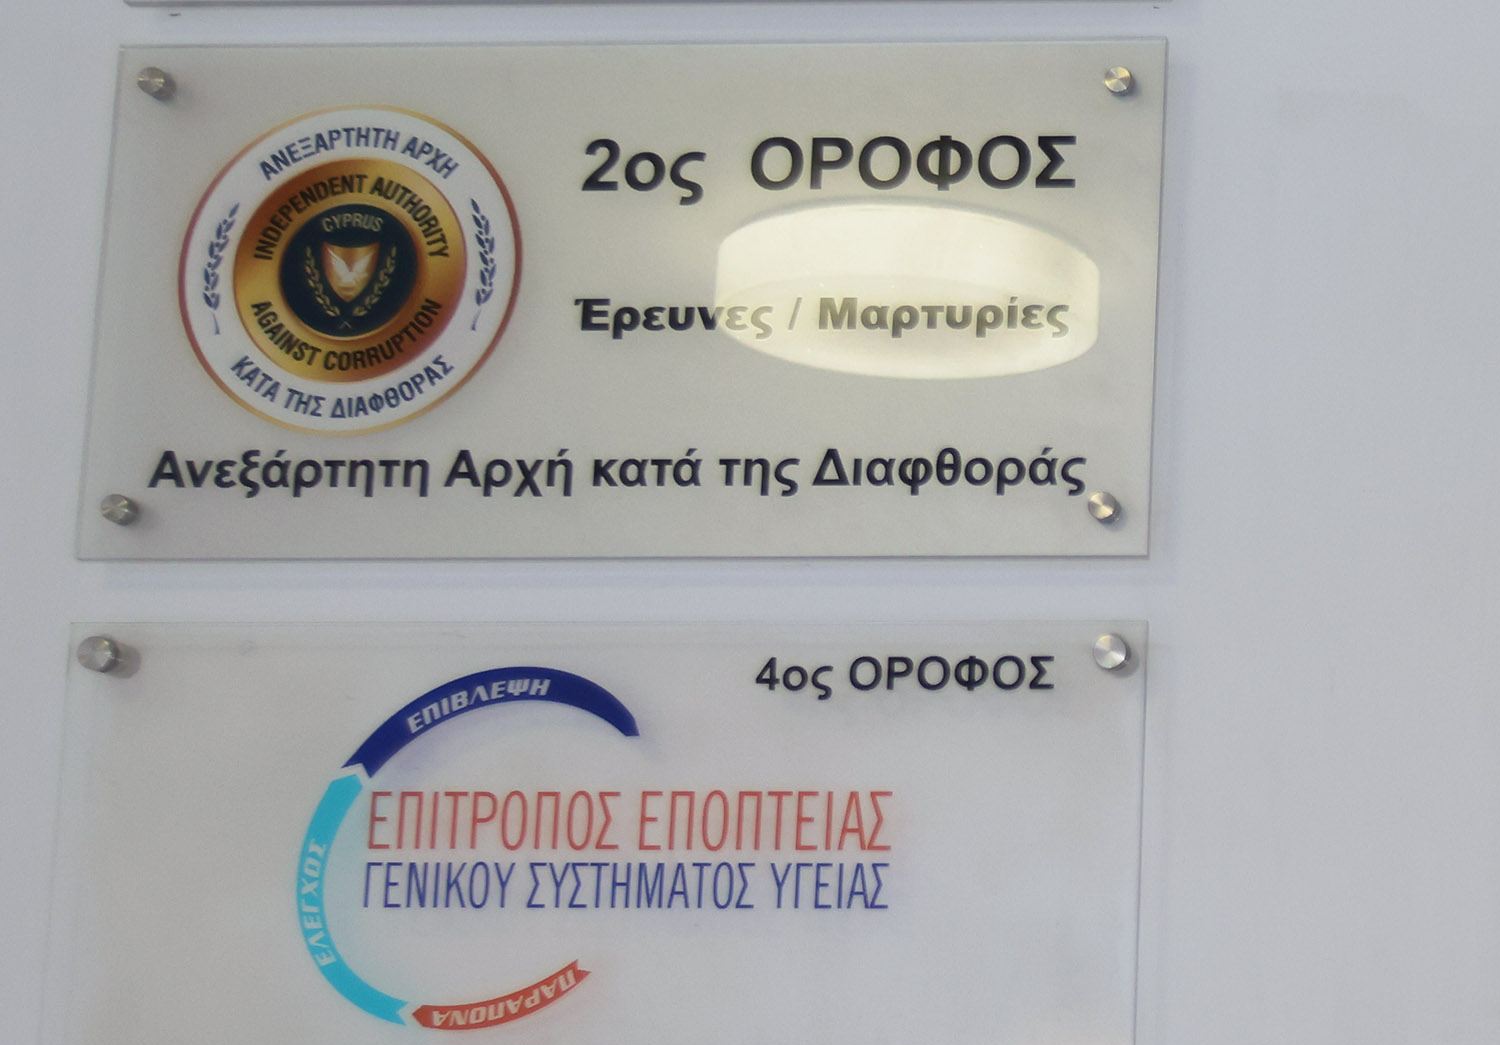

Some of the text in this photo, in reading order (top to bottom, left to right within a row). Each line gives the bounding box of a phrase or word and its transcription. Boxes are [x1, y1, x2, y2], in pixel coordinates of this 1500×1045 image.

[259, 126, 460, 181] ΑΝΕΞΑΡΤΗΤΗ ΑΡΧΗ
[581, 135, 1078, 206] 2ος ΟΡΟΦΟΣ
[253, 174, 451, 260] INDEPENDENT AUTHORITY
[321, 212, 385, 233] CYPRUS
[250, 298, 443, 371] AGAINST CORRUPTION
[574, 297, 774, 340] Έρευνες
[818, 296, 1071, 339] Μαρτυρίες
[230, 354, 455, 420] ΚΑΤΑ ΤΗΣ ΔΙΑΦΘΟΡΑΣ
[148, 446, 1087, 498] Ανεξάρτητη Αρχή κατά της Διαφθοράς
[405, 677, 552, 736] ΕΠΙΒΛΕΨΗ
[755, 654, 1055, 701] 4ος ΟΡΟΦΟΣ
[366, 790, 893, 852] ΕΠΙΤΡΟΠΟΣ ΕΠΟΠΤΕΙΑΣ
[301, 838, 335, 968] ΕΛΕΓΧΟΣ
[362, 861, 891, 910] ΓΕΝΙΚΟΥ ΣΥΣΤΗΜΑΤΟΣ ΥΓΕΙΑΣ
[431, 967, 578, 1028] ΠΑΡΑΠΟΝΑ
